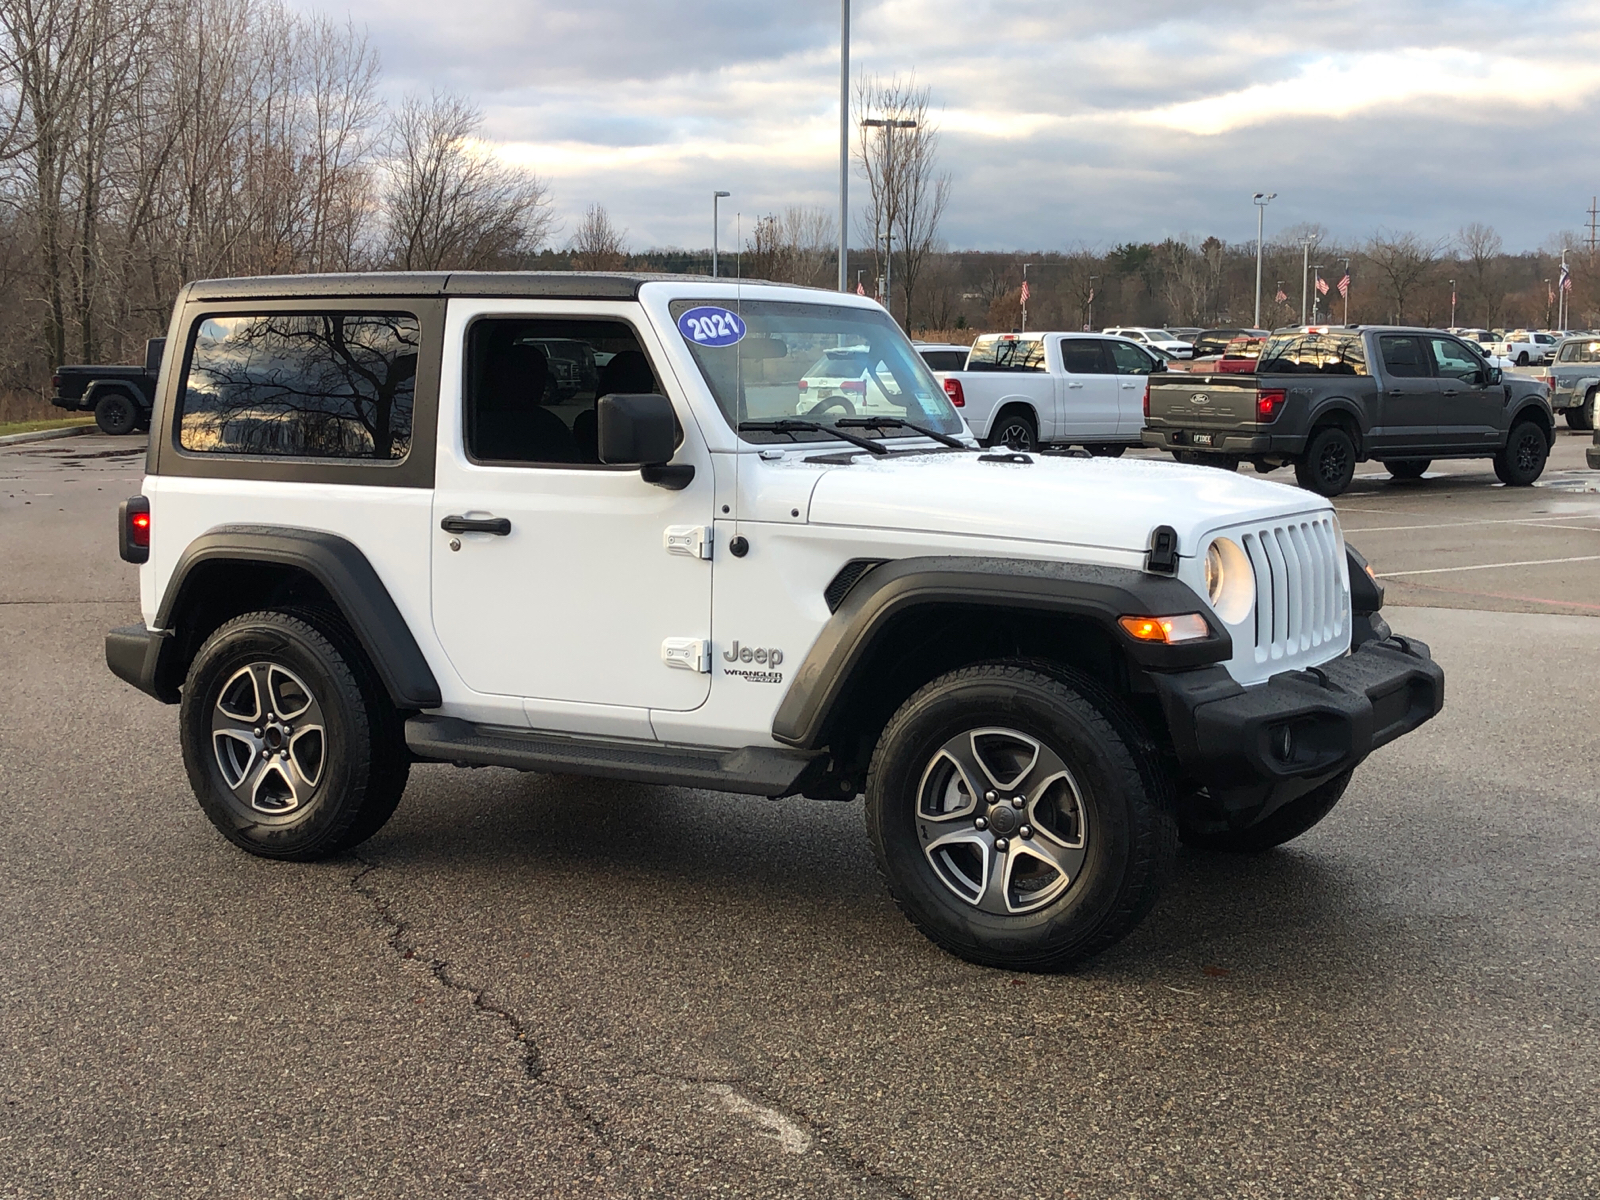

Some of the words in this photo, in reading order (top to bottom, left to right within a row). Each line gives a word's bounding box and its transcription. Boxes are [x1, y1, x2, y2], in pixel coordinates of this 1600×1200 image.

[687, 312, 740, 340] 2021
[723, 640, 783, 669] Jeep
[723, 669, 783, 678] WRANGLER
